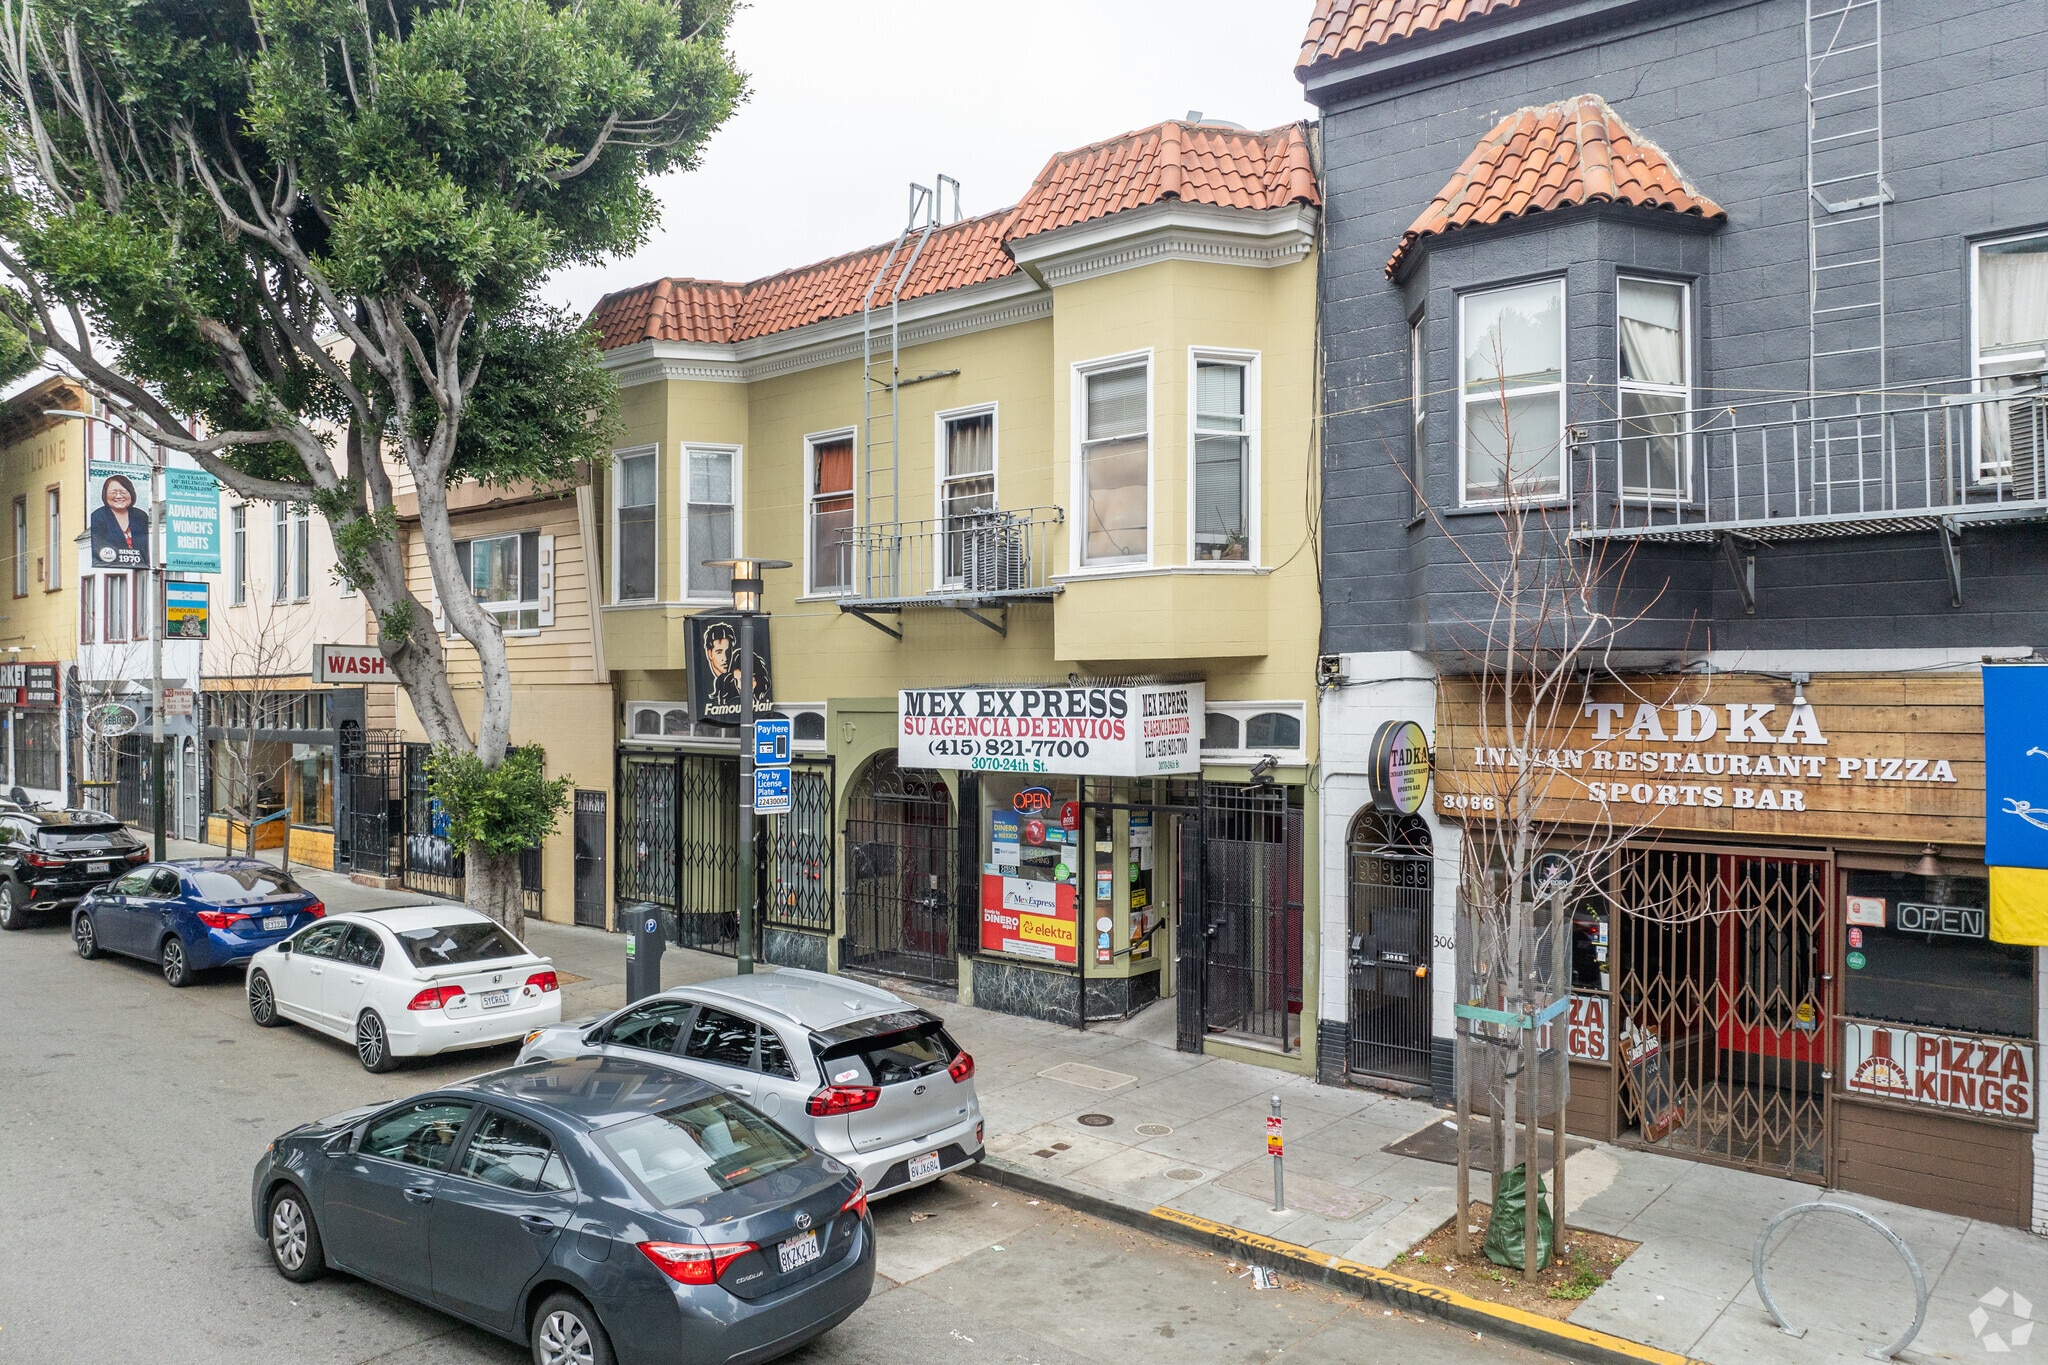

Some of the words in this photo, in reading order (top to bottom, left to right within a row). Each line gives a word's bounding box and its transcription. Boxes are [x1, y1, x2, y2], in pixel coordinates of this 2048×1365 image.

[168, 504, 217, 520] ADVANCING
[172, 520, 213, 535] WOMEN'S
[177, 536, 209, 549] RIGHTS
[118, 554, 140, 563] 1970
[0, 665, 26, 686] RKET
[704, 702, 742, 716] Famou
[752, 699, 774, 713] Hair
[904, 691, 966, 717] MEX
[976, 689, 1128, 719] EXPRESS
[1142, 693, 1157, 717] MEX
[1158, 690, 1188, 716] EXPRESS
[757, 725, 771, 735] Pay
[771, 724, 788, 733] here
[904, 716, 927, 736] SU
[929, 717, 1015, 737] AGENCIA
[1017, 717, 1044, 738] DE
[1047, 718, 1126, 741] ENVIOS
[1150, 719, 1169, 738] AGENCIA
[1174, 716, 1190, 735] ENVIOS
[1584, 703, 1828, 745] TADKA
[928, 739, 981, 757] (415)
[985, 739, 1090, 758] 821-7700
[1391, 746, 1427, 767] TADKA
[971, 757, 1029, 772] 3070-24th
[1033, 759, 1048, 773] St.
[1390, 770, 1403, 778] INDIAN
[1403, 767, 1428, 776] RESTAURANT
[1592, 750, 1826, 777] RESTAURANT
[1837, 757, 1957, 783] PIZZA
[757, 772, 770, 781] Pay
[771, 771, 780, 780] by
[757, 779, 782, 788] License
[757, 788, 775, 796] Plate
[1013, 792, 1051, 809] OPEN
[1588, 781, 1723, 808] SPORTS
[1732, 787, 1806, 812] BAR
[1443, 794, 1495, 811] 3066
[993, 824, 1018, 832] DINERO
[1538, 878, 1568, 886] SAPORO
[1014, 894, 1056, 908] MexExpress
[984, 913, 1019, 926] DINERO
[1902, 906, 1981, 934] OPEN
[1035, 923, 1073, 940] elektra
[1434, 935, 1454, 950] 306
[1916, 1036, 2029, 1083] PIZZA
[914, 1085, 926, 1095] KIA
[1915, 1069, 2029, 1114] KINGS
[911, 1160, 938, 1178] 8VJX684
[1164, 1211, 1201, 1225] SFMTA
[781, 1238, 817, 1266] 8KZK276
[736, 1270, 764, 1284] COROLLA
